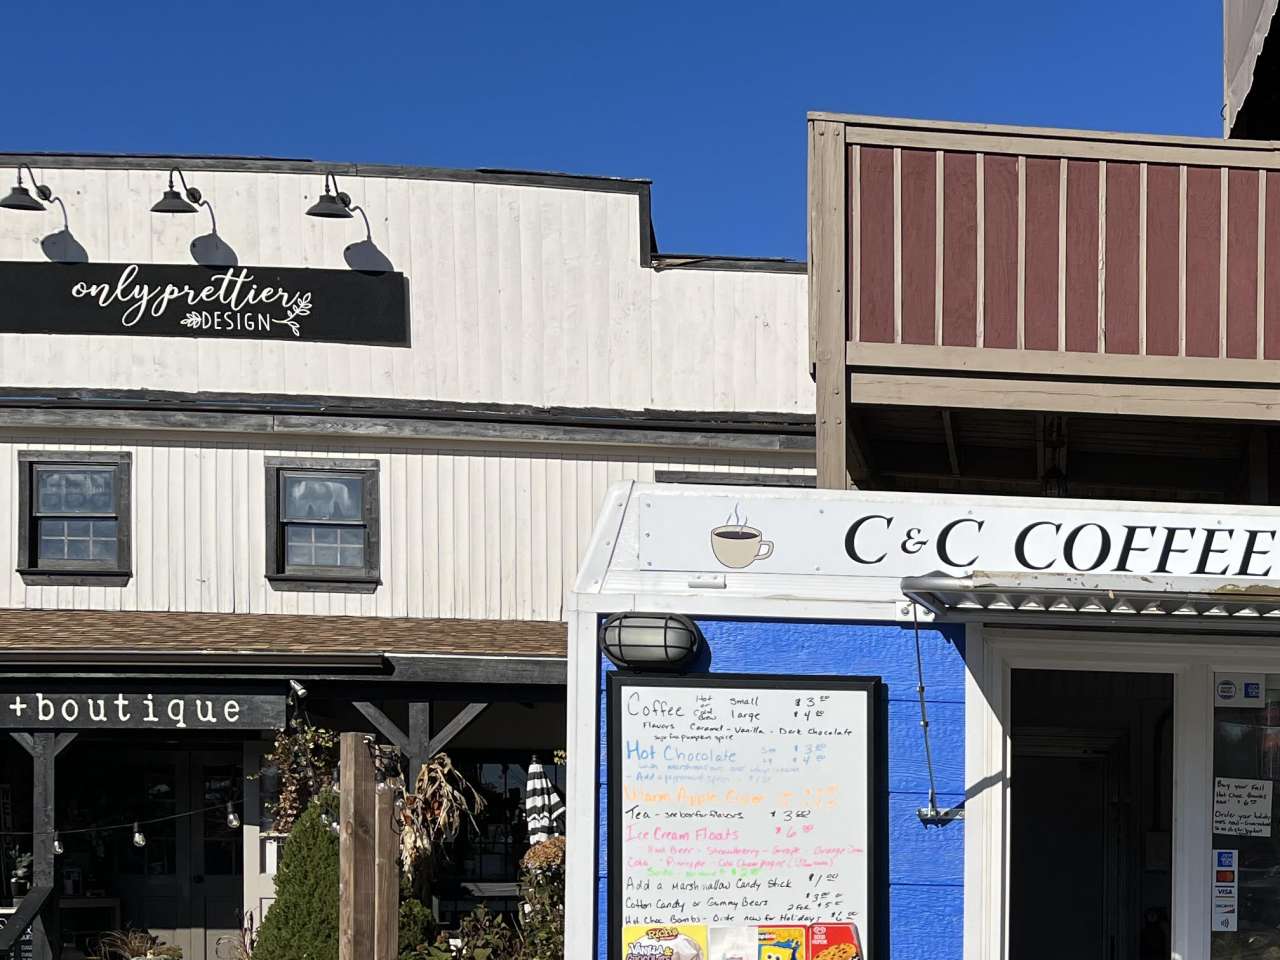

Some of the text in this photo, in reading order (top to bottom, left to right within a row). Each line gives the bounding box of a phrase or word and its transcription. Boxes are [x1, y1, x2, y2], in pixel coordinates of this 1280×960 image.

[201, 310, 271, 332] DESIGN
[1013, 520, 1277, 577] COFFEE
[627, 691, 684, 717] Coffee
[626, 740, 657, 761] Hot
[664, 744, 737, 763] Chocolate
[625, 804, 651, 820] Tea
[625, 824, 649, 842] Ice
[653, 826, 690, 841] Cream
[695, 825, 740, 841] Floats
[626, 876, 650, 890] Add
[735, 878, 761, 892] Candy
[625, 896, 652, 909] Cotton
[656, 898, 686, 913] Candy
